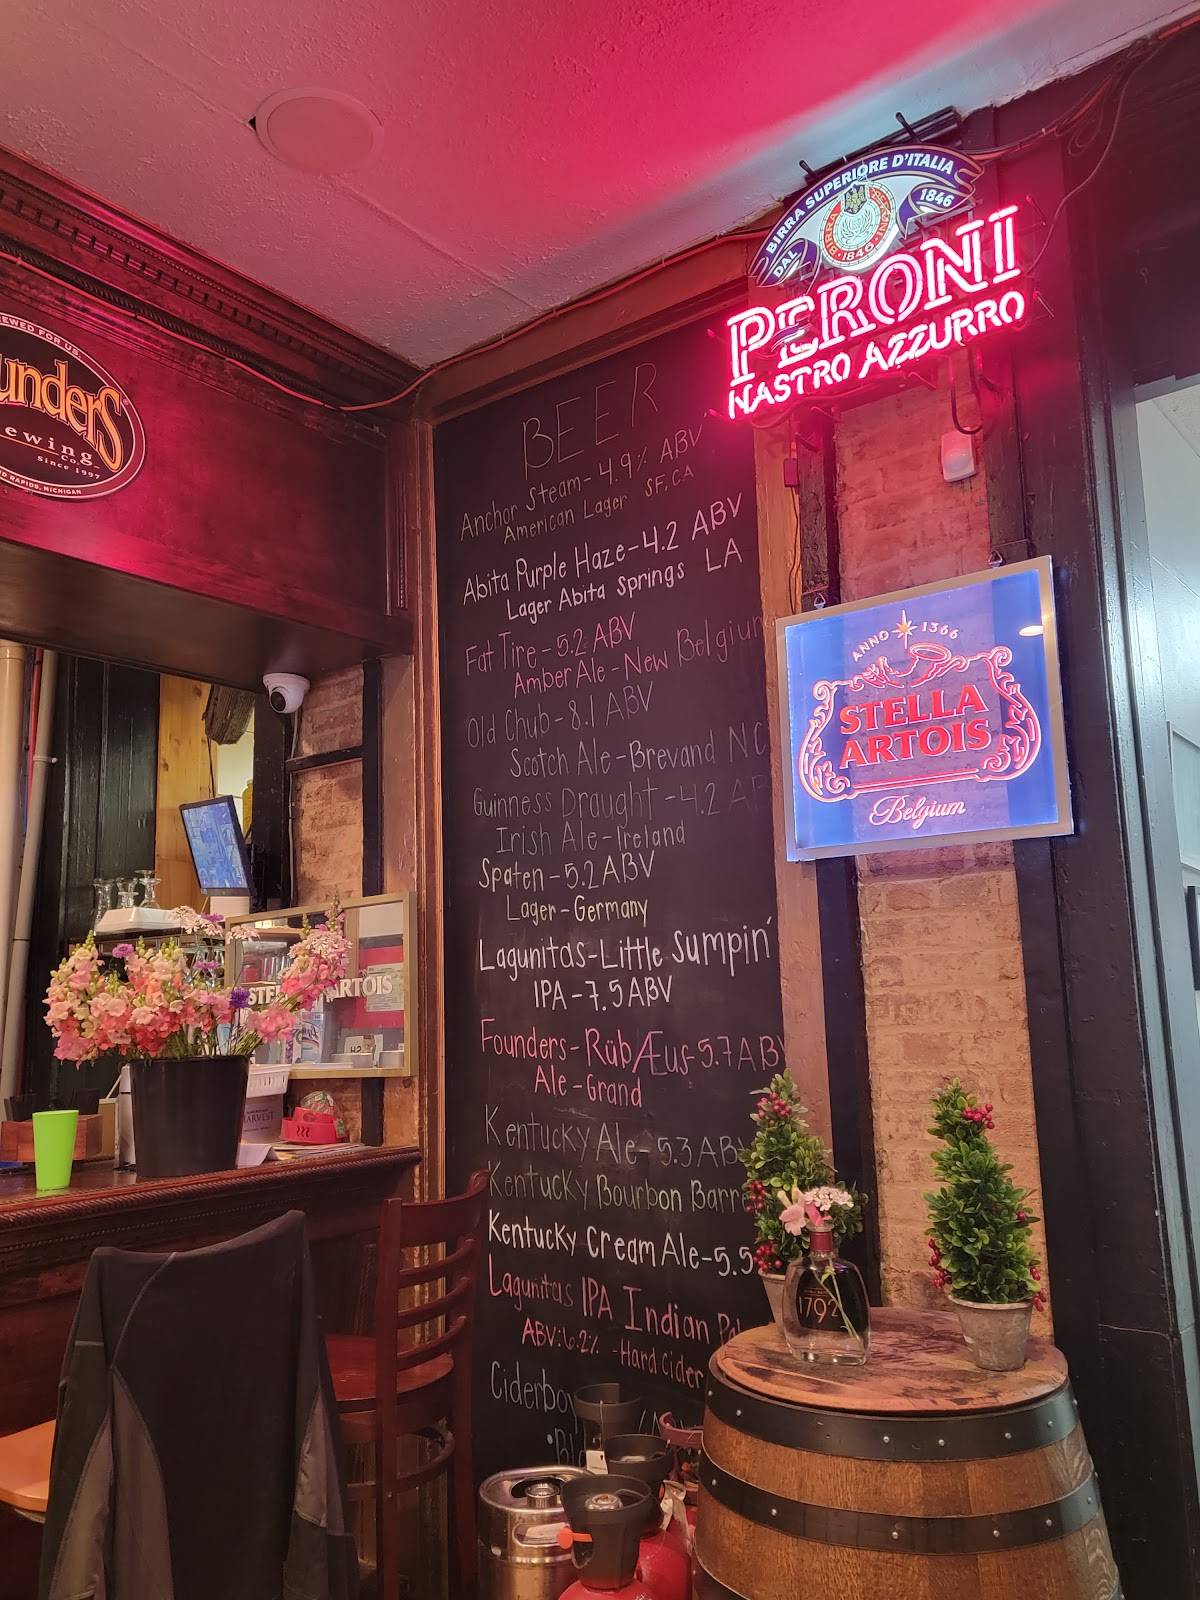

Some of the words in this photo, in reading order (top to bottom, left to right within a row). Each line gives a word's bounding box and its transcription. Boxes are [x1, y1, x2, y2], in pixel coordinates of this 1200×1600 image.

[766, 209, 806, 255] BIRRA
[806, 157, 888, 210] SUPERIORE
[892, 153, 955, 175] D'ITALIA
[773, 250, 798, 279] DAL
[920, 187, 956, 208] 1846
[842, 242, 875, 262] 1846
[726, 204, 1021, 387] PERONI
[0, 315, 35, 333] EWED
[38, 329, 61, 345] FOR
[728, 352, 851, 420] NASTRO
[858, 290, 1025, 379] AZZURRO
[522, 361, 659, 481] BEER
[38, 455, 69, 470] Since
[75, 467, 101, 480] 1997
[460, 500, 518, 541] Anchor
[660, 424, 703, 463] ABV
[503, 507, 575, 544] American
[583, 494, 628, 519] Lager
[463, 570, 510, 606] Abita
[515, 551, 567, 592] Purple
[691, 492, 743, 541] ABV
[506, 598, 553, 625] Lager
[559, 583, 606, 611] Abita
[616, 561, 686, 599] Springs
[705, 537, 743, 573] LA
[465, 639, 495, 676] Fat
[498, 631, 537, 670] Tire
[592, 610, 636, 654] ABV
[852, 629, 890, 663] ANNO
[921, 621, 960, 640] 1366
[513, 665, 572, 699] Amber
[467, 712, 497, 749] Old
[605, 681, 654, 726] ABV
[838, 684, 990, 736] STELLA
[510, 745, 569, 779] Scotch
[838, 718, 993, 770] ARTOIS
[473, 787, 552, 819] Guinness
[561, 777, 661, 828] Draught
[868, 793, 967, 830] Belgium
[495, 823, 552, 856] Irish
[627, 974, 674, 1008] ABV
[484, 1103, 592, 1162] Kentucky
[697, 1134, 746, 1170] AB
[487, 1159, 590, 1211] Kentucky
[596, 1173, 682, 1213] Bourbon
[488, 1208, 577, 1257] Kentucky
[586, 1224, 657, 1268] Cream
[487, 1252, 575, 1312] Lagunitas
[581, 1275, 613, 1321] IPA
[622, 1284, 711, 1345] Indian
